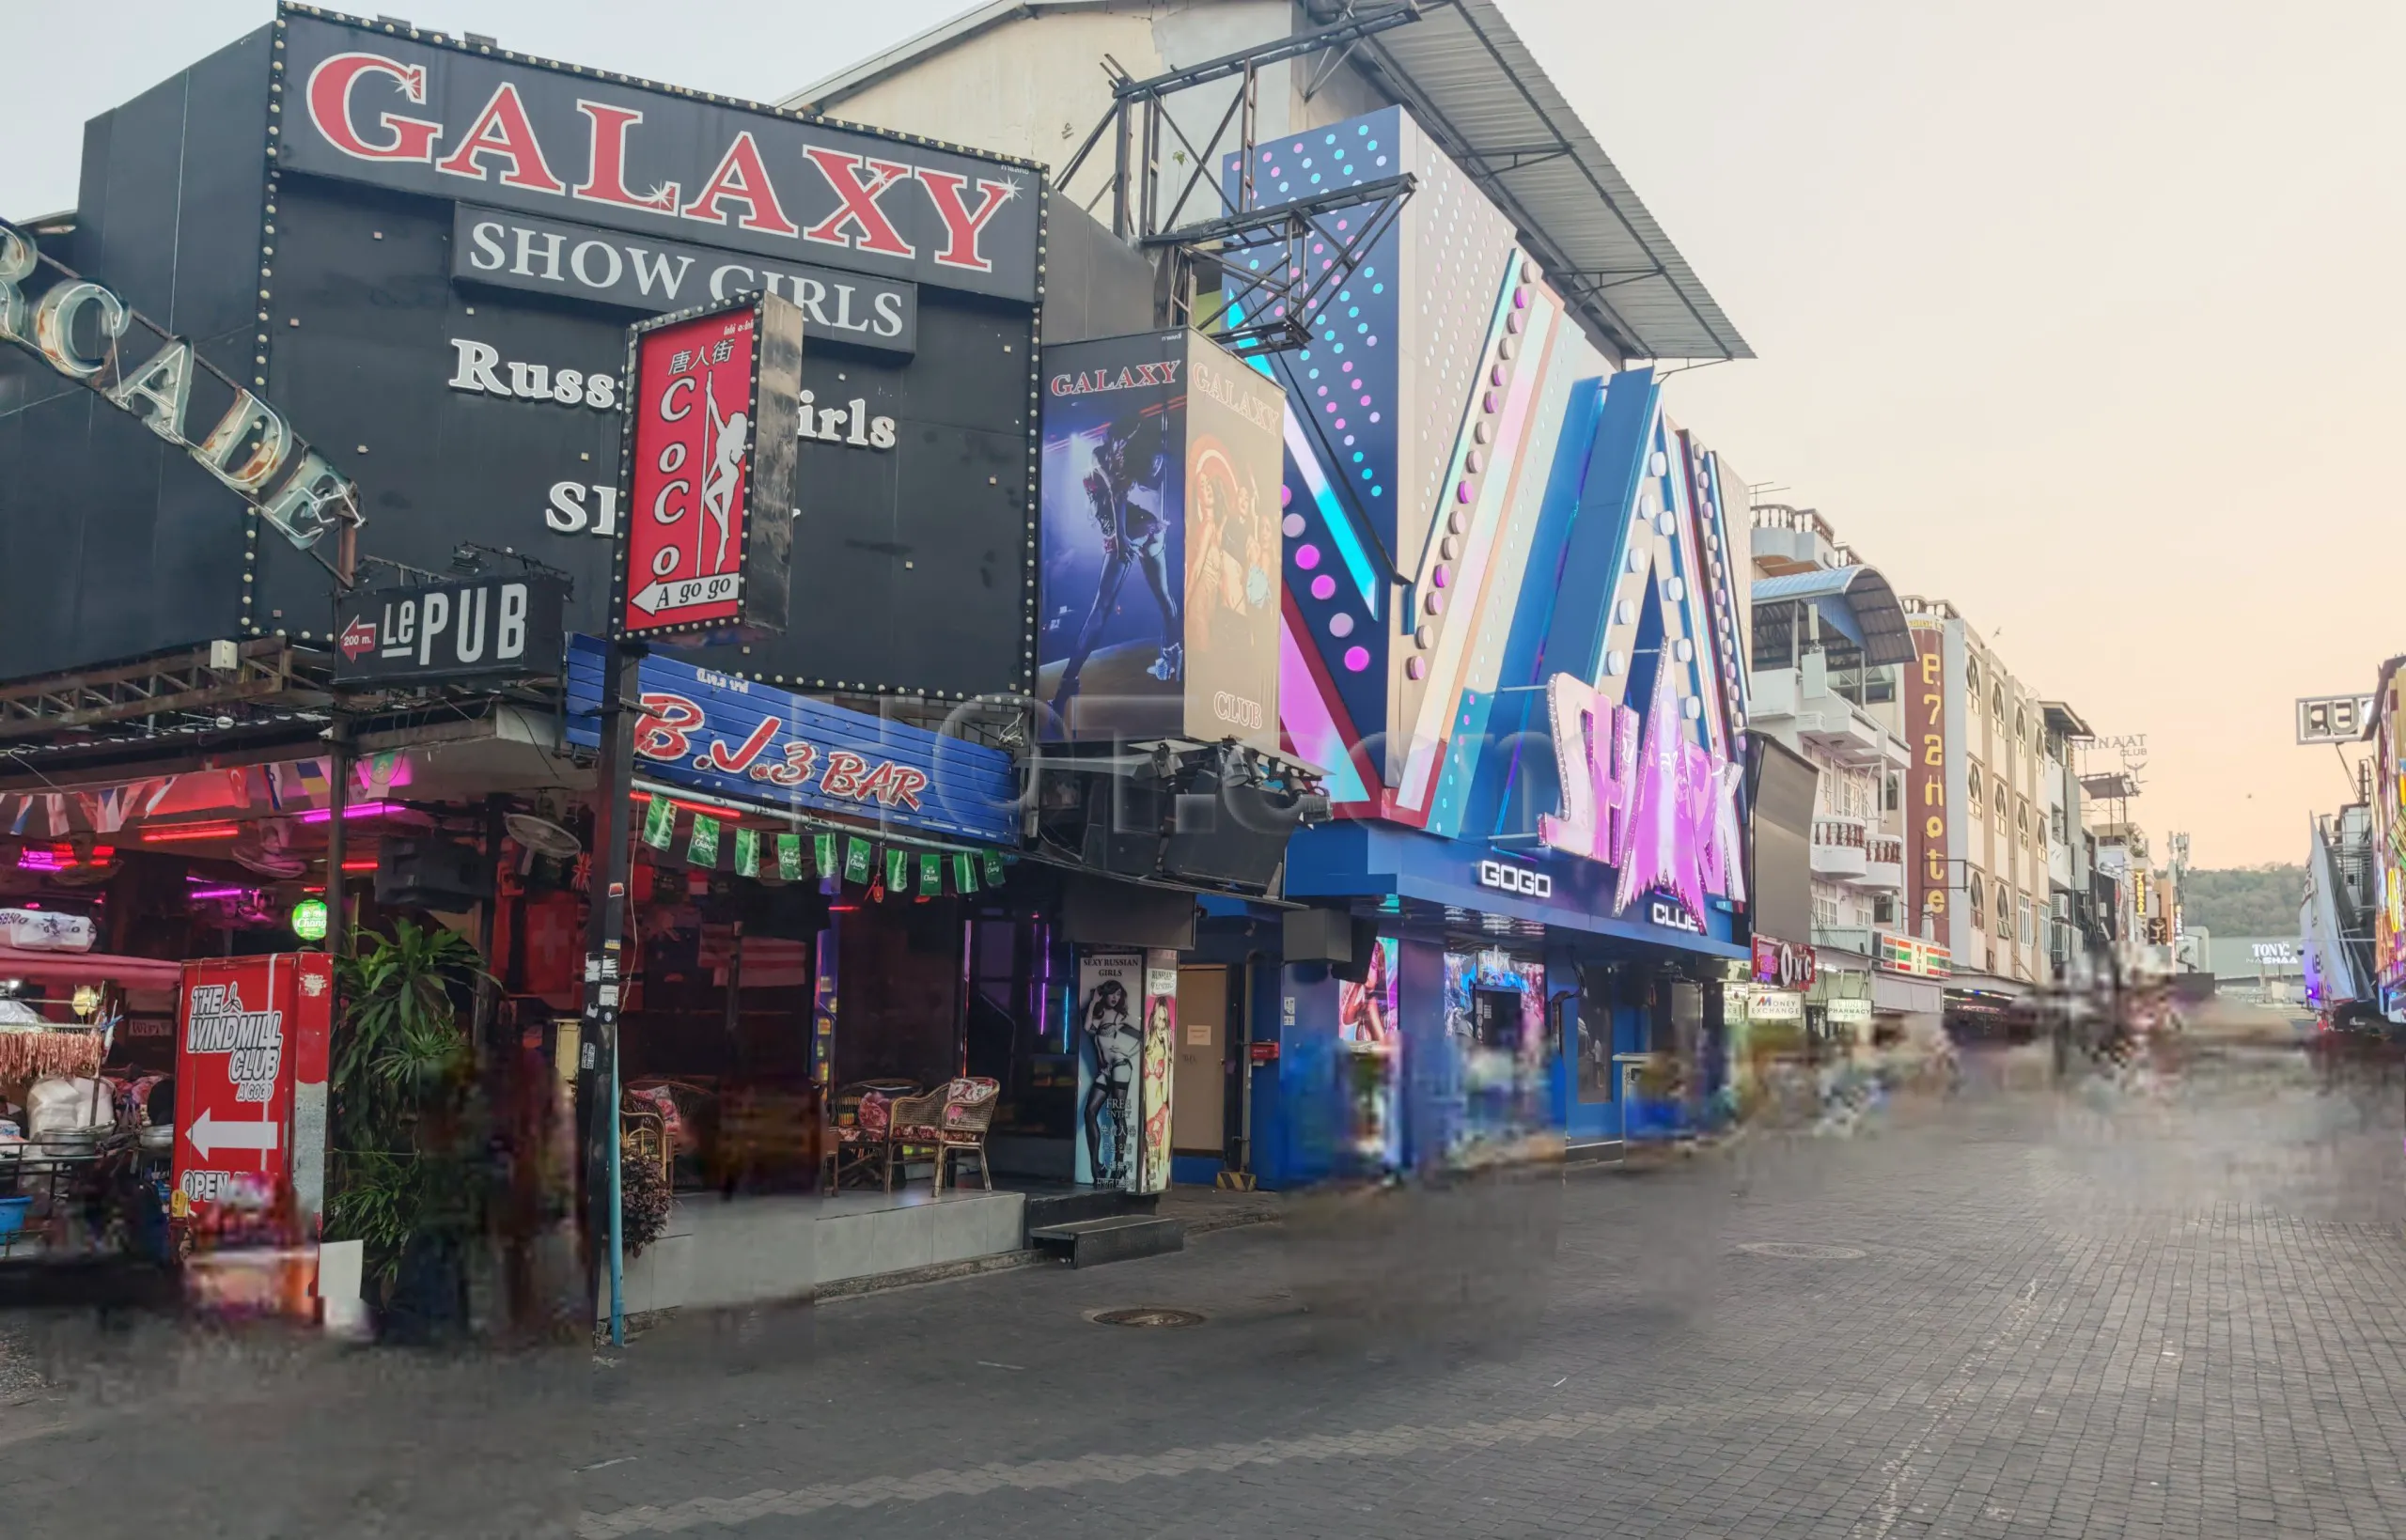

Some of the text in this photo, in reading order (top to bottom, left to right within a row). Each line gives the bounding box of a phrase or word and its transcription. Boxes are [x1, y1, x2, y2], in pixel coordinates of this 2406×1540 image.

[306, 52, 1020, 273] GALAXY
[471, 222, 695, 300] SHOW
[668, 337, 735, 376] 唐人街
[449, 338, 898, 449] Russ irls
[1051, 359, 1182, 397] GALAXY
[1193, 362, 1279, 438] GALAXY
[679, 576, 703, 606] go
[708, 573, 732, 601] go
[344, 635, 359, 646] 200
[419, 583, 528, 665] PUB
[1213, 690, 1263, 730] CLUB
[2119, 748, 2148, 757] CLUB
[820, 751, 929, 813] BAR
[1480, 860, 1552, 898] GOGO
[1084, 958, 1139, 967] SEXY RUSSIAN
[1098, 969, 1123, 977] GIRLS
[193, 987, 226, 1016] THE
[1751, 1007, 1801, 1016] EXCHANGE
[1828, 1007, 1871, 1016] PHARMACY
[187, 1012, 283, 1052] WINDMILL
[230, 1049, 280, 1082] CLUB
[1106, 1097, 1132, 1109] FREE
[1106, 1111, 1132, 1119] ENTRY
[180, 1172, 229, 1203] OPEN
